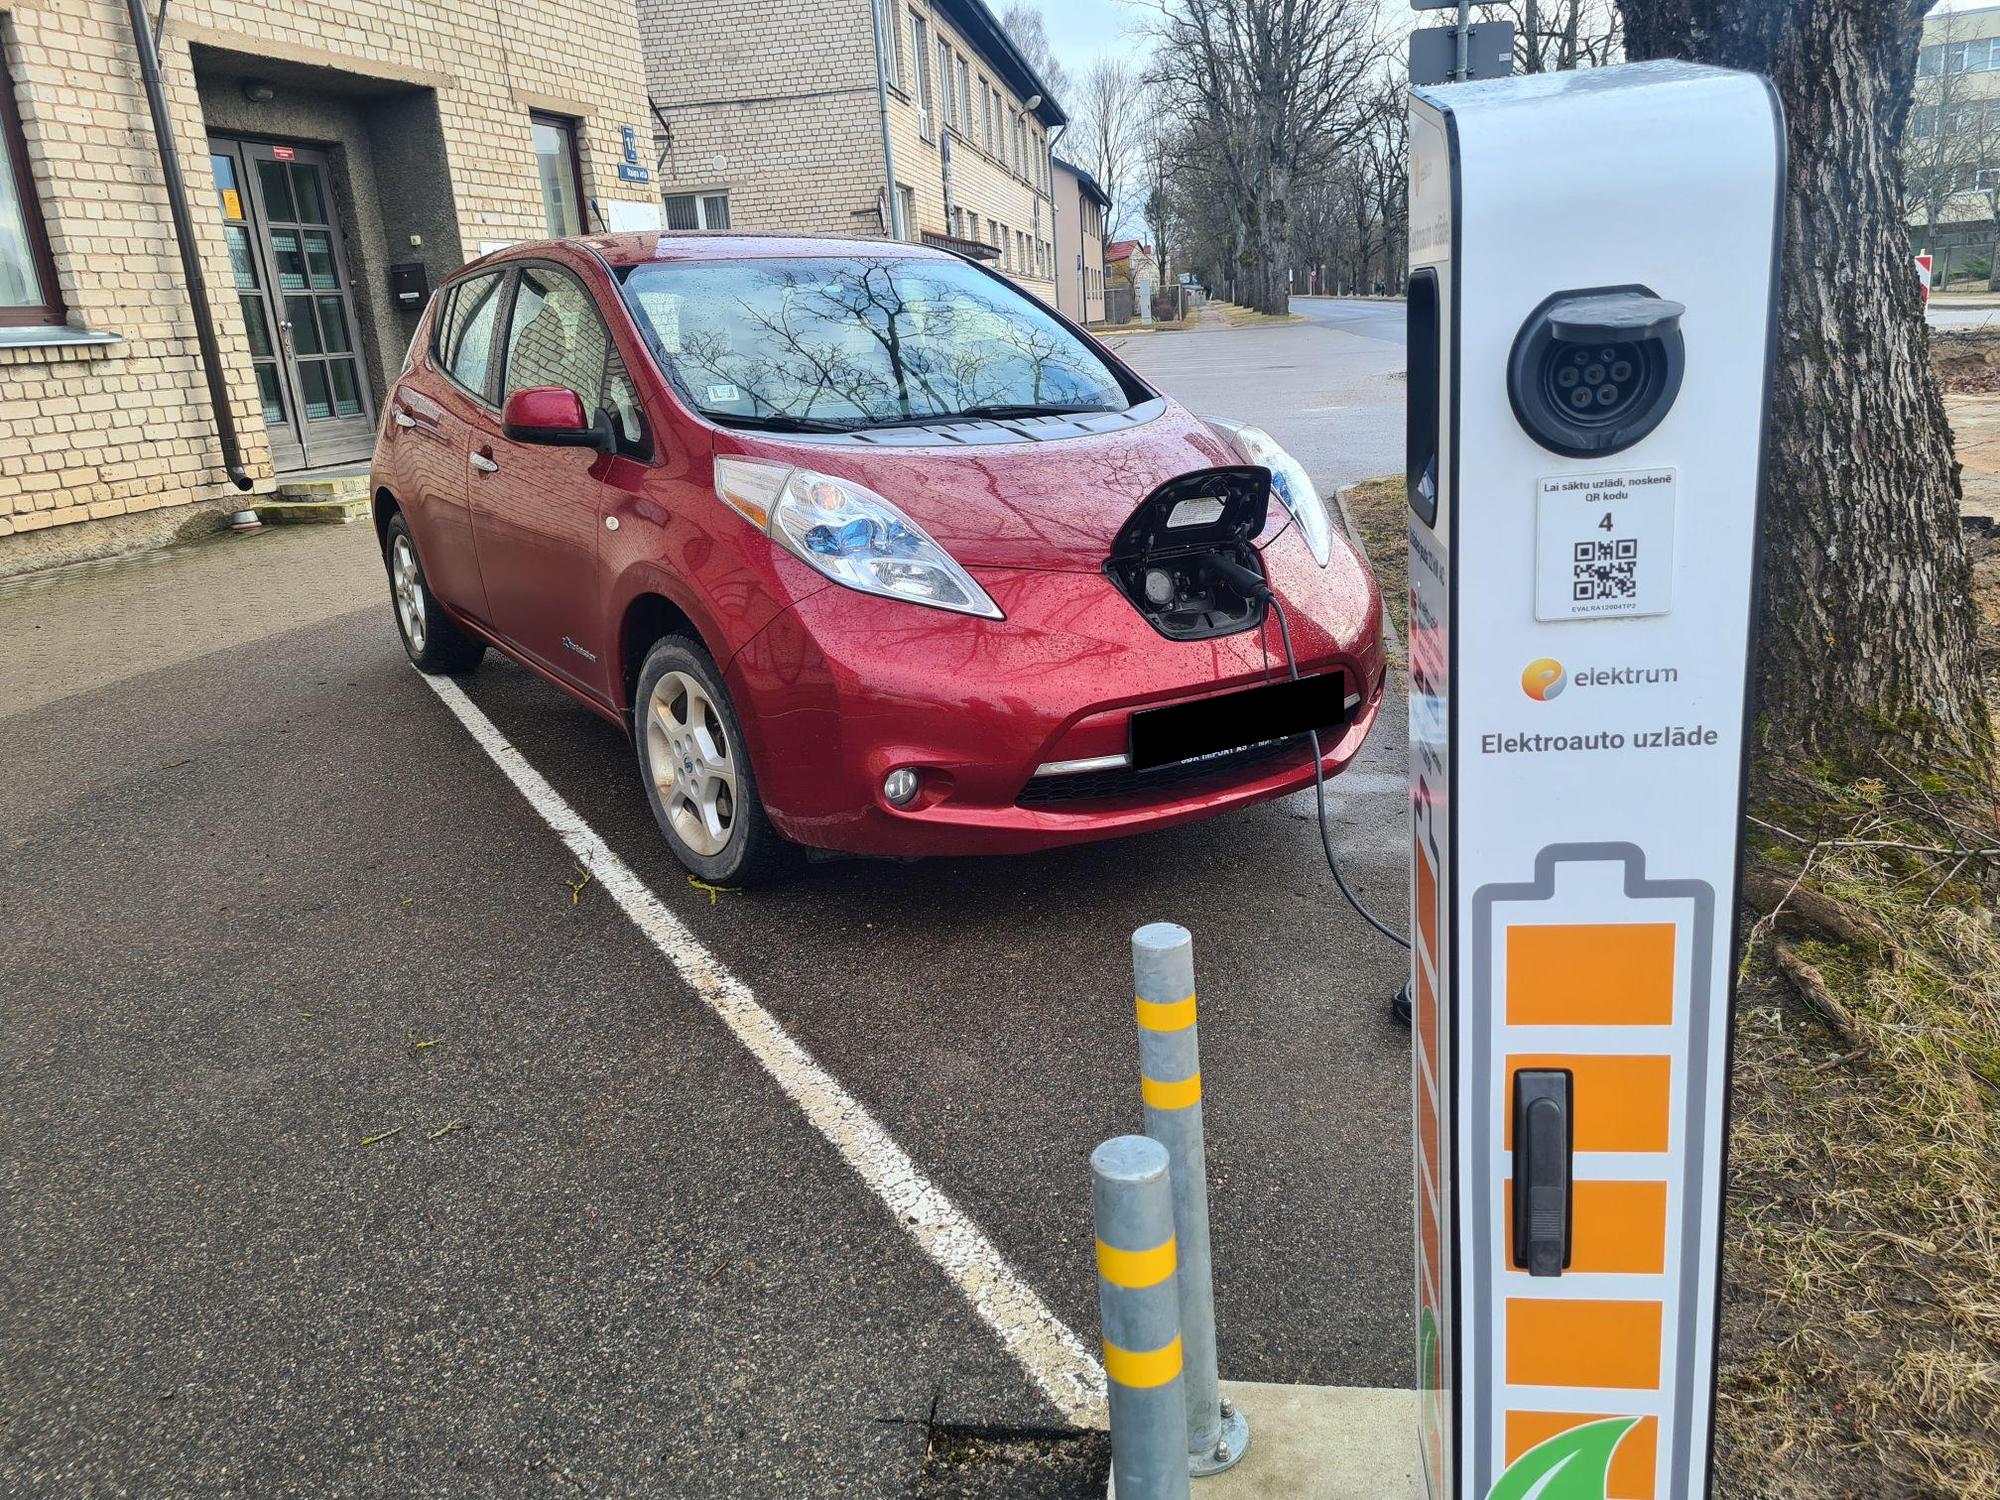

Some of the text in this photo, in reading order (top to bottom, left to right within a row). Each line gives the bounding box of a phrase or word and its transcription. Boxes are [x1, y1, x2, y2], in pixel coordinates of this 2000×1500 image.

[1544, 474, 1672, 492] Lai sāktu uzlādi, noskenē
[1585, 490, 1628, 502] QR kodu
[1598, 512, 1613, 532] 4
[1574, 666, 1678, 687] elektrum
[1481, 725, 1719, 754] Elektroauto uzlāde
